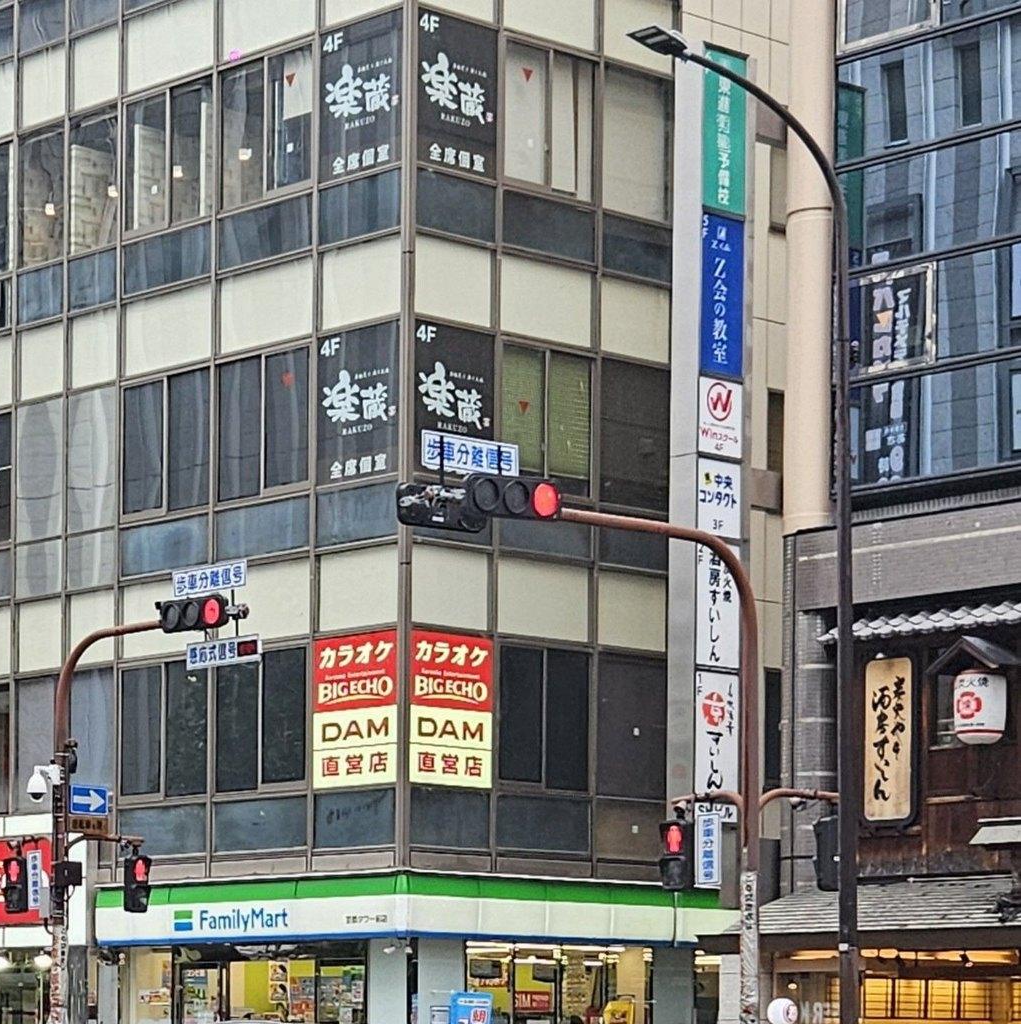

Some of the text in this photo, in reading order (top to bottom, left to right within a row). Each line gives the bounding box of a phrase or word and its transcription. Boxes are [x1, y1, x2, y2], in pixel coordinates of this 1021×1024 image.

[419, 13, 439, 32] 4F
[323, 32, 343, 52] 4F
[325, 64, 390, 118] 楽蔵
[422, 52, 485, 124] 楽蔵
[344, 115, 375, 130] RAKUZO
[440, 112, 471, 127] RAKUZO
[333, 144, 389, 174] 全席個室
[429, 143, 485, 172] 全席個室
[712, 257, 728, 364] Z会の教室
[320, 337, 340, 357] 4F
[416, 325, 437, 343] 4F
[322, 369, 388, 423] 楽蔵
[418, 361, 482, 430] 楽蔵
[330, 453, 386, 480] 全席個室
[427, 438, 513, 472] 歩車分離信号
[714, 473, 733, 490] 中央
[699, 489, 737, 509] コンタクト
[713, 519, 723, 530] 3F
[177, 566, 242, 594] 歩車分離信号
[319, 641, 393, 669] カラオケ
[415, 640, 488, 667] カラオケ
[318, 675, 393, 704] BIG ECHO
[414, 674, 488, 702] BIG ECHO
[321, 717, 389, 742] DAM
[417, 716, 484, 742] DAM
[321, 752, 388, 777] 直営店
[417, 752, 482, 777] 直営店
[200, 907, 288, 932] FamilyMart
